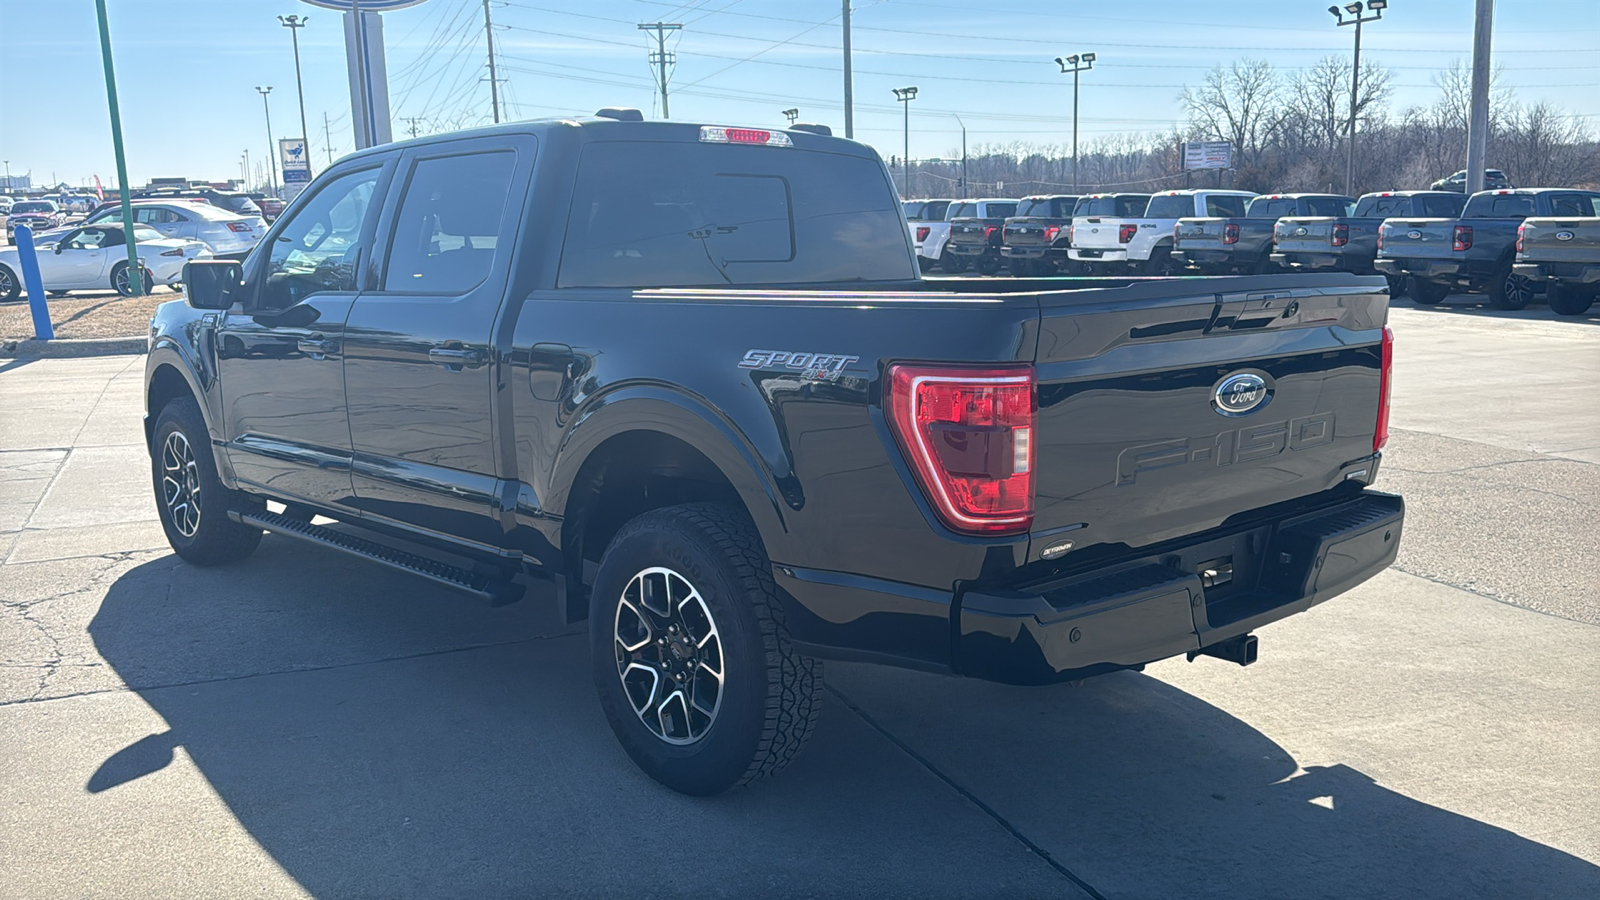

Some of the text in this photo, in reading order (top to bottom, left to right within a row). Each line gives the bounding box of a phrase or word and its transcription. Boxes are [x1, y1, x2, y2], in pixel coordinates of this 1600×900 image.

[737, 348, 860, 370] SPORT
[1230, 382, 1257, 404] Ford
[1115, 411, 1336, 486] F-150
